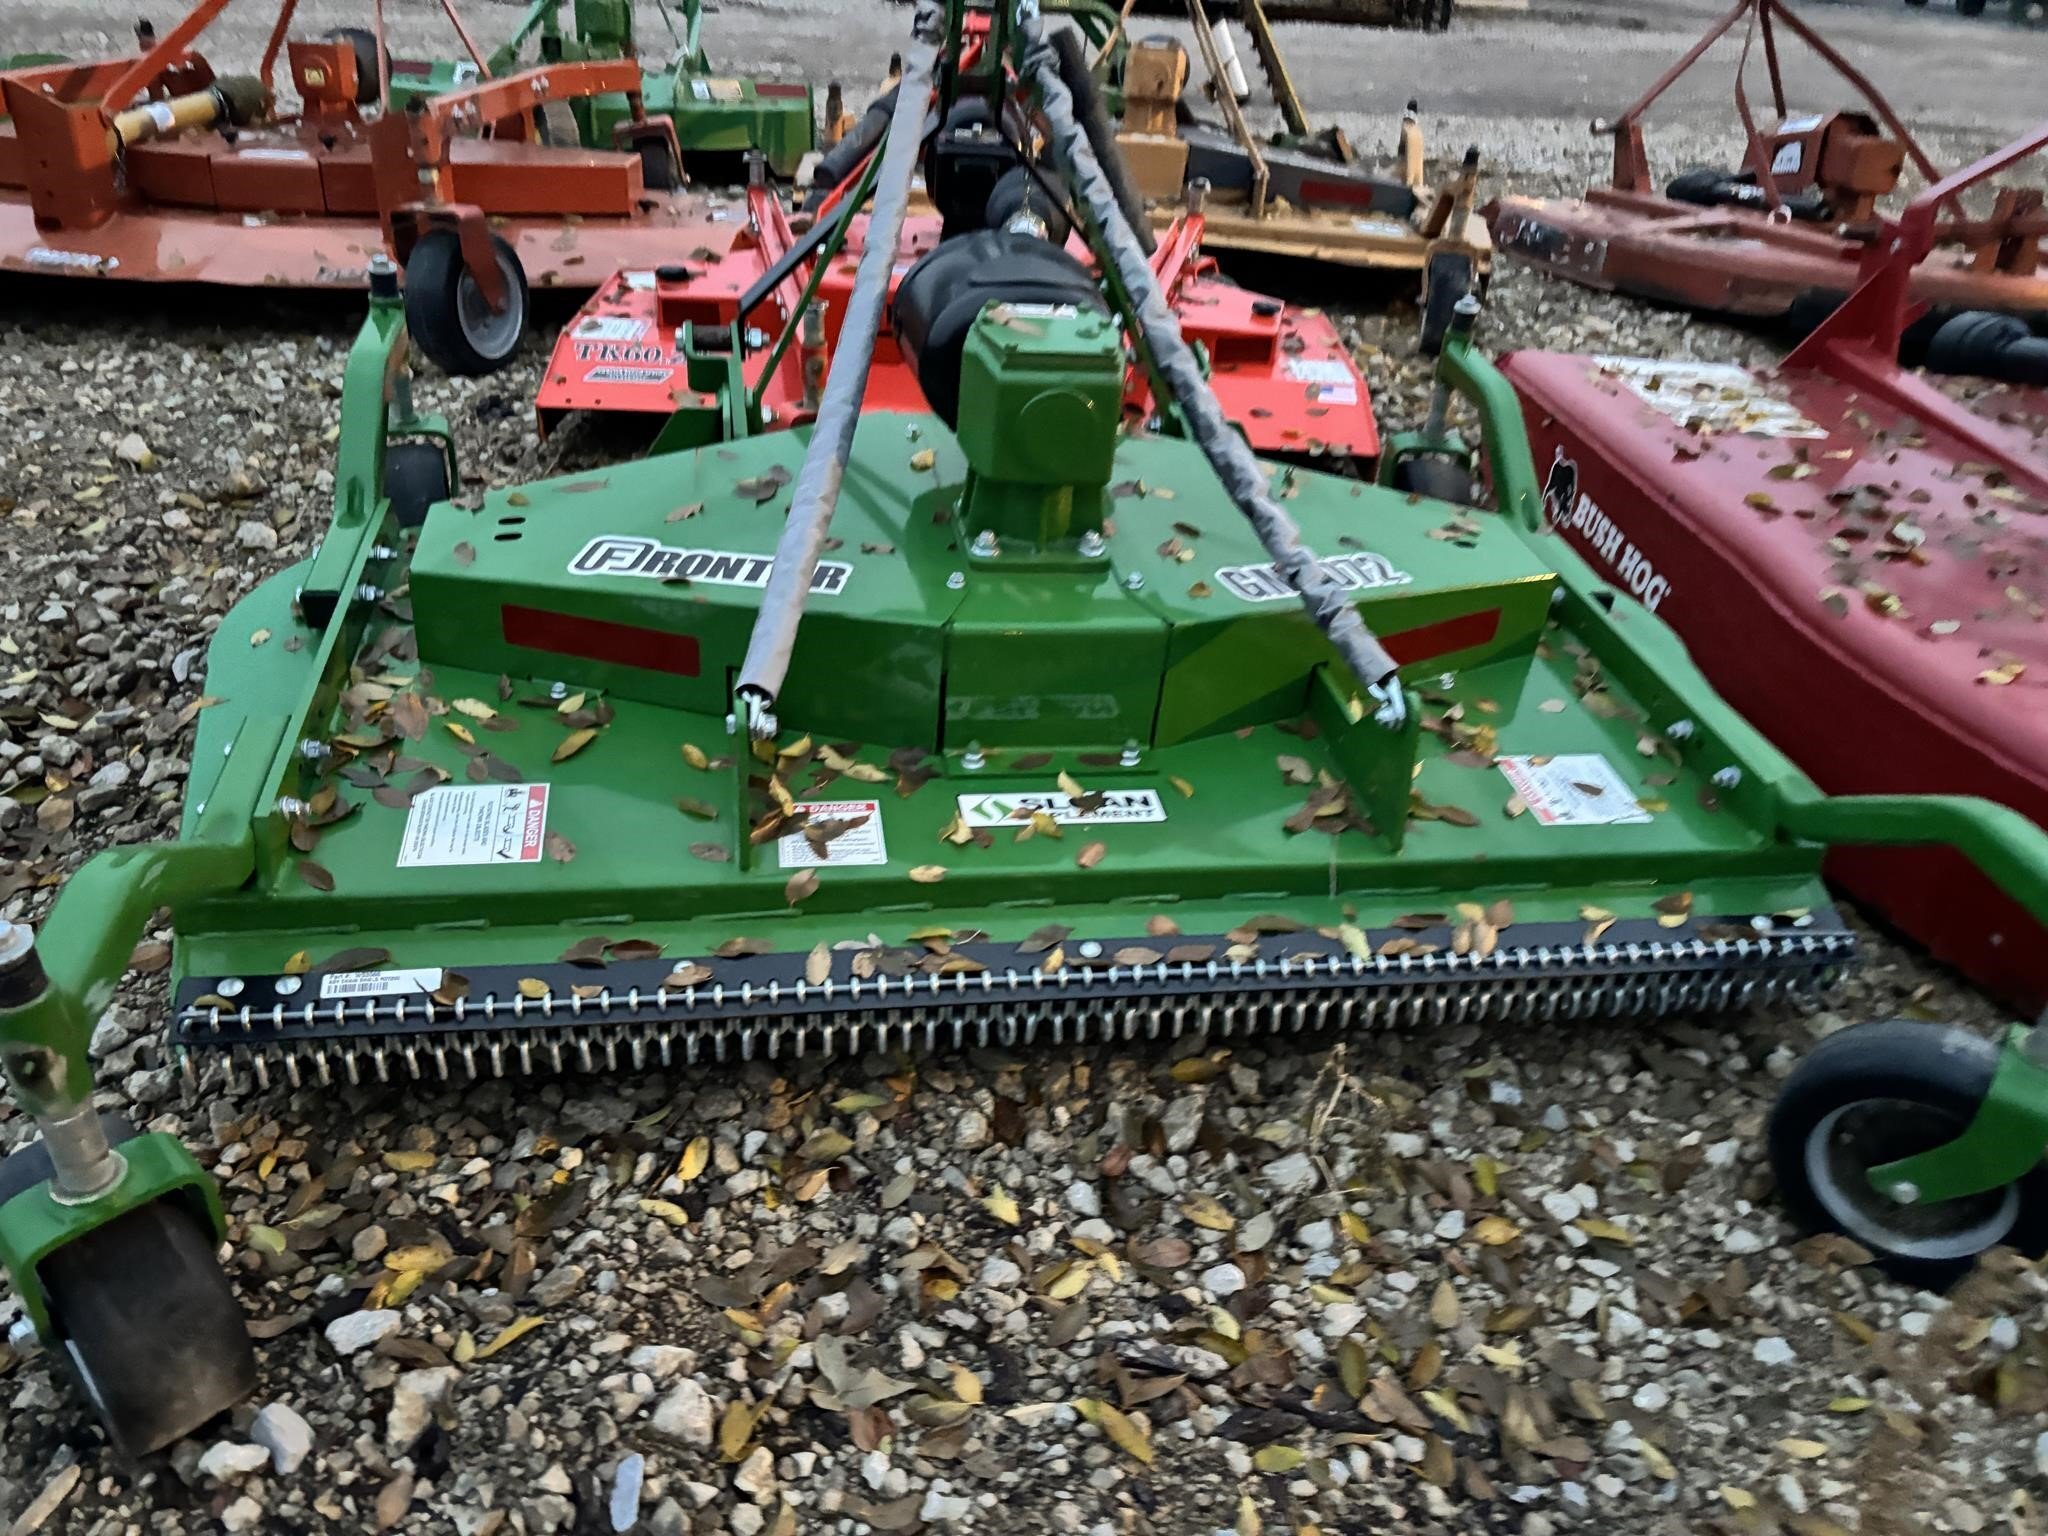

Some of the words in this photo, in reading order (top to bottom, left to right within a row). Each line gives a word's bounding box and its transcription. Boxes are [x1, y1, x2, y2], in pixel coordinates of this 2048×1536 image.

[573, 539, 847, 590] FRONTR
[1572, 492, 1625, 565] BUSH
[1617, 542, 1671, 612] HOG
[1019, 795, 1151, 811] SLAN
[525, 809, 543, 848] DANGER
